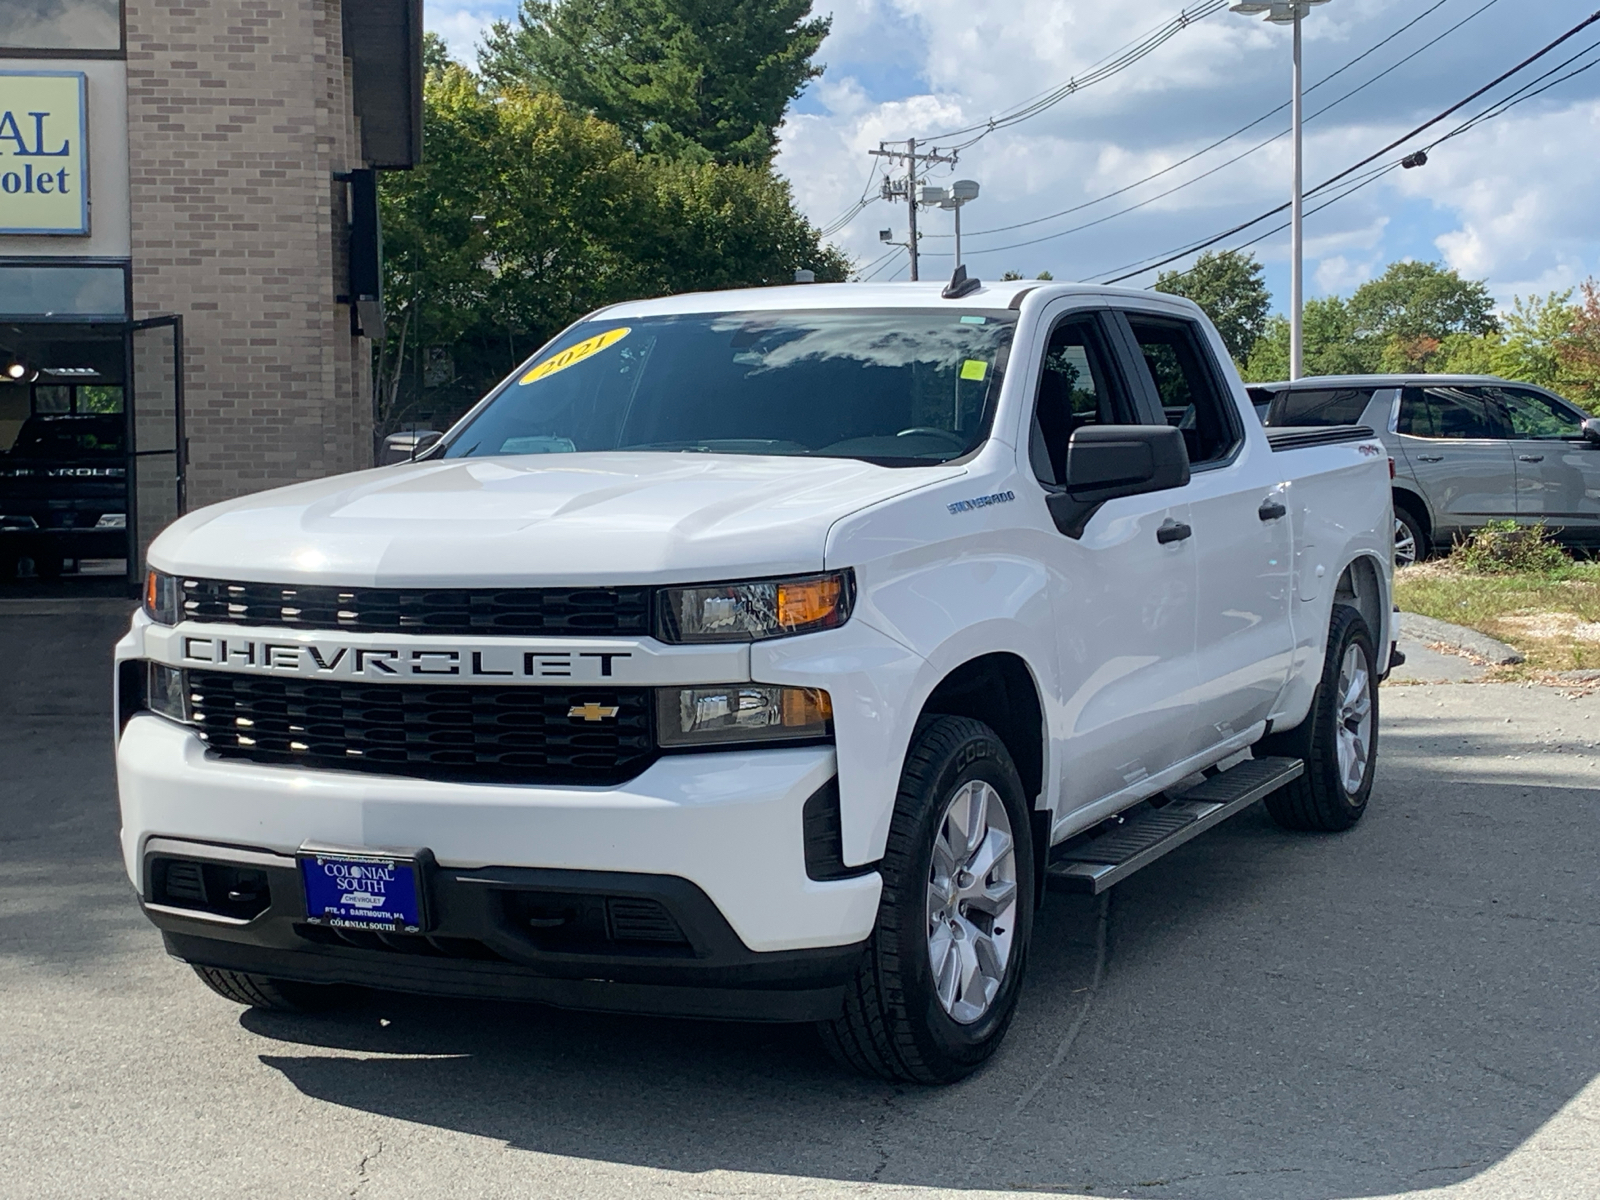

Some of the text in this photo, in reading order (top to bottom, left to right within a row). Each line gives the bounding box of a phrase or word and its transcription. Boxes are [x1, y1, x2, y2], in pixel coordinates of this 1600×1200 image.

[539, 335, 607, 378] 2021
[946, 490, 1016, 515] SILVERADO
[184, 636, 632, 678] CHEVROLET
[955, 740, 1013, 775] COOP
[324, 863, 395, 882] COLONIAL
[336, 877, 386, 893] SOUTH
[344, 894, 382, 904] CHEVROLET
[329, 918, 396, 932] COLONIAL SOUTH
